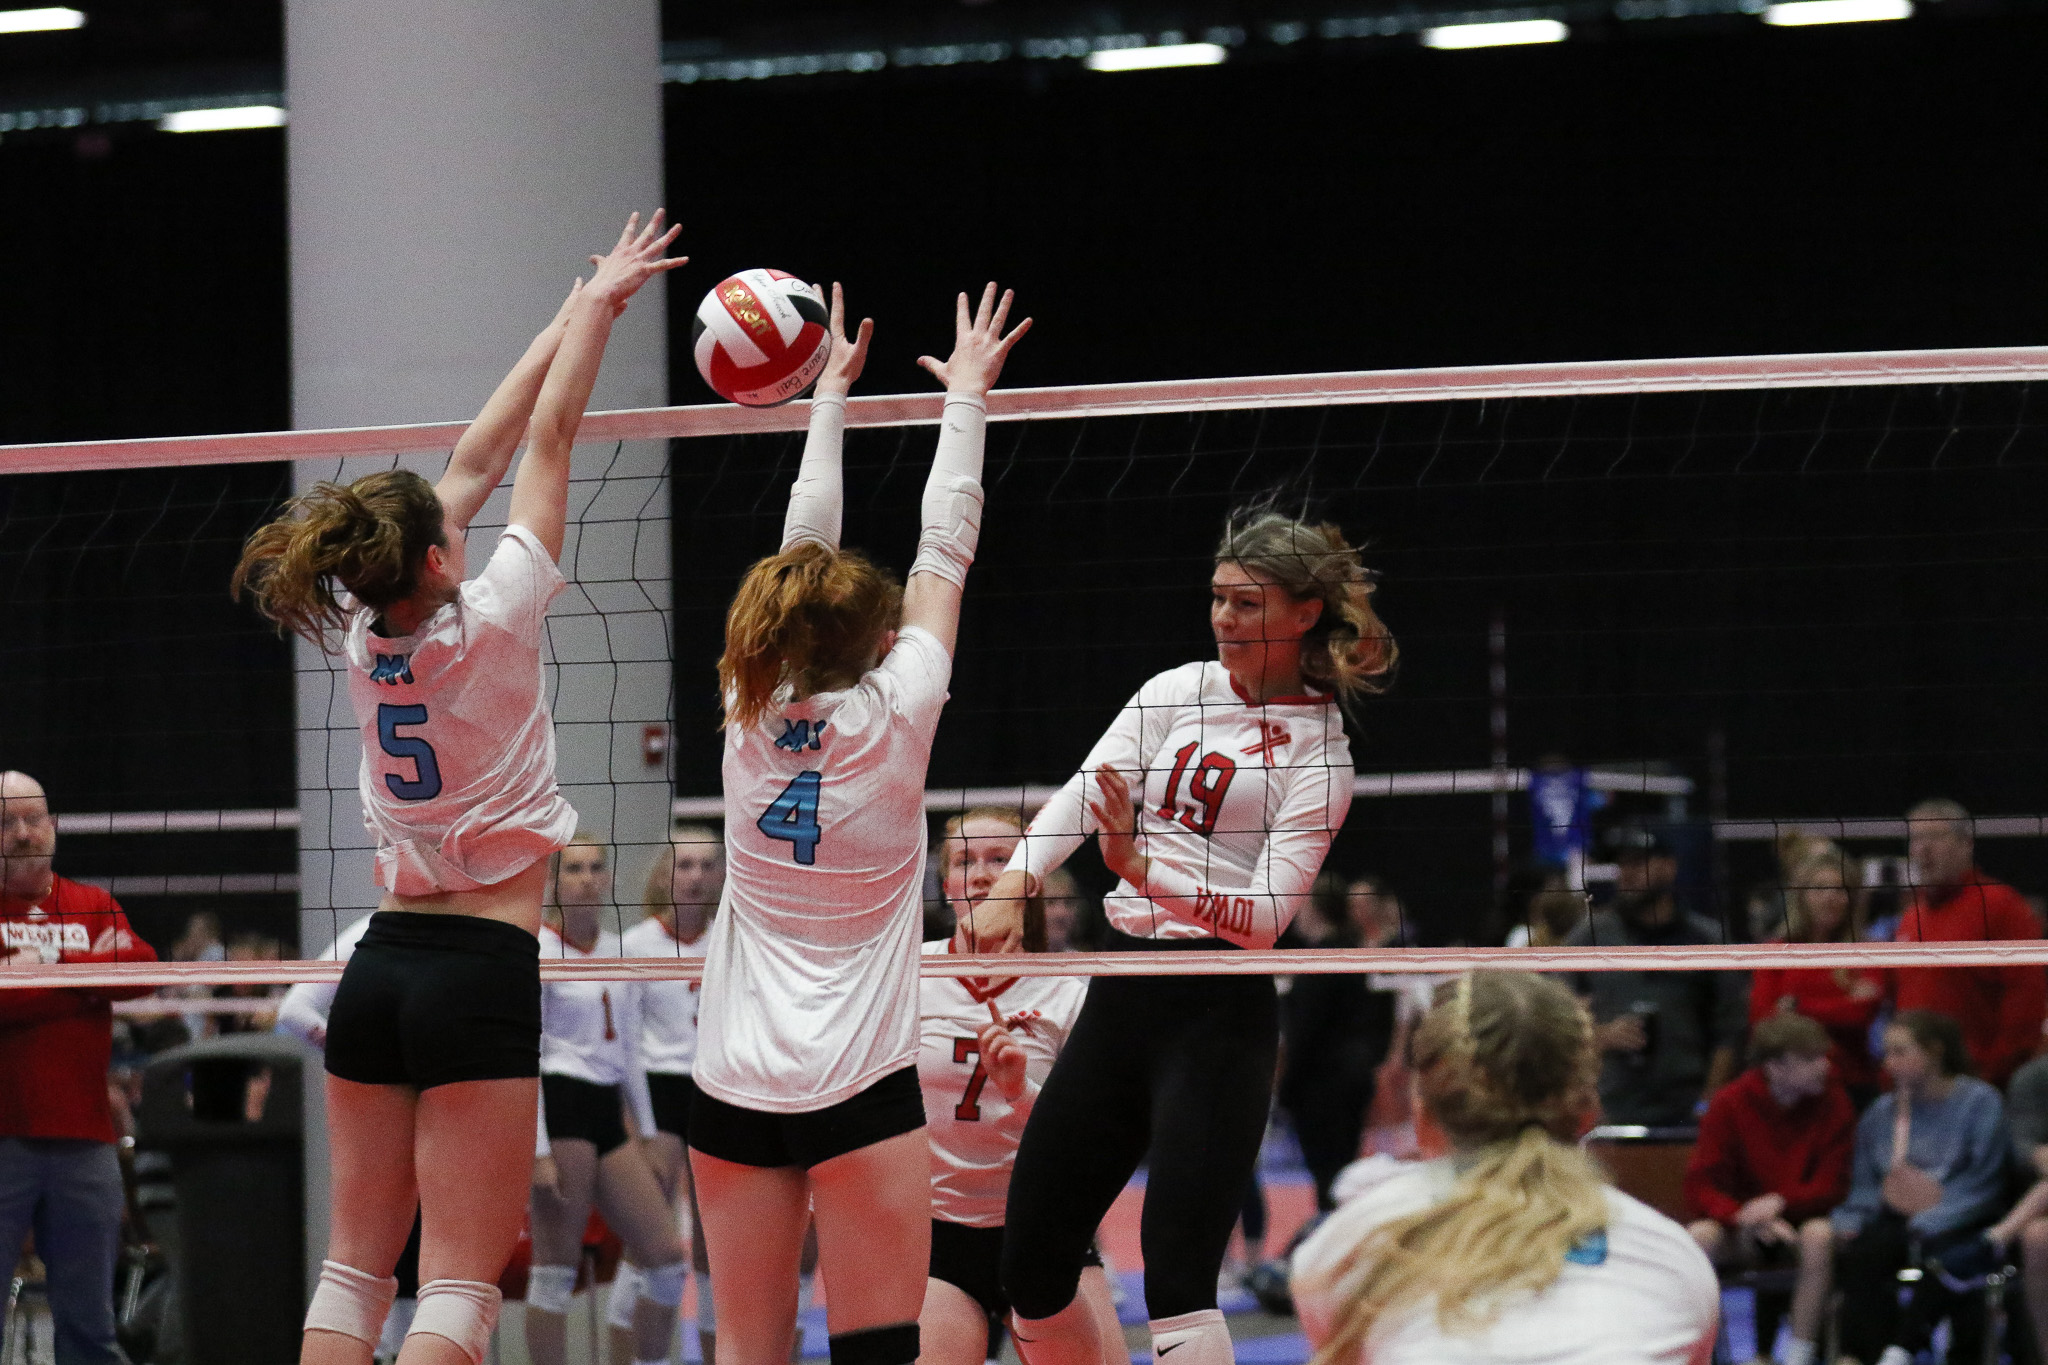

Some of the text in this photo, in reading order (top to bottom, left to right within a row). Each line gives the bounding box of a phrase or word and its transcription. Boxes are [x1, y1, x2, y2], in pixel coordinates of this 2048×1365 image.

[776, 345, 828, 397] Game Ball
[377, 702, 443, 801] 5
[1156, 740, 1236, 836] 19
[756, 770, 823, 866] 4
[1193, 886, 1255, 937] IOWA
[952, 1036, 989, 1122] 7
